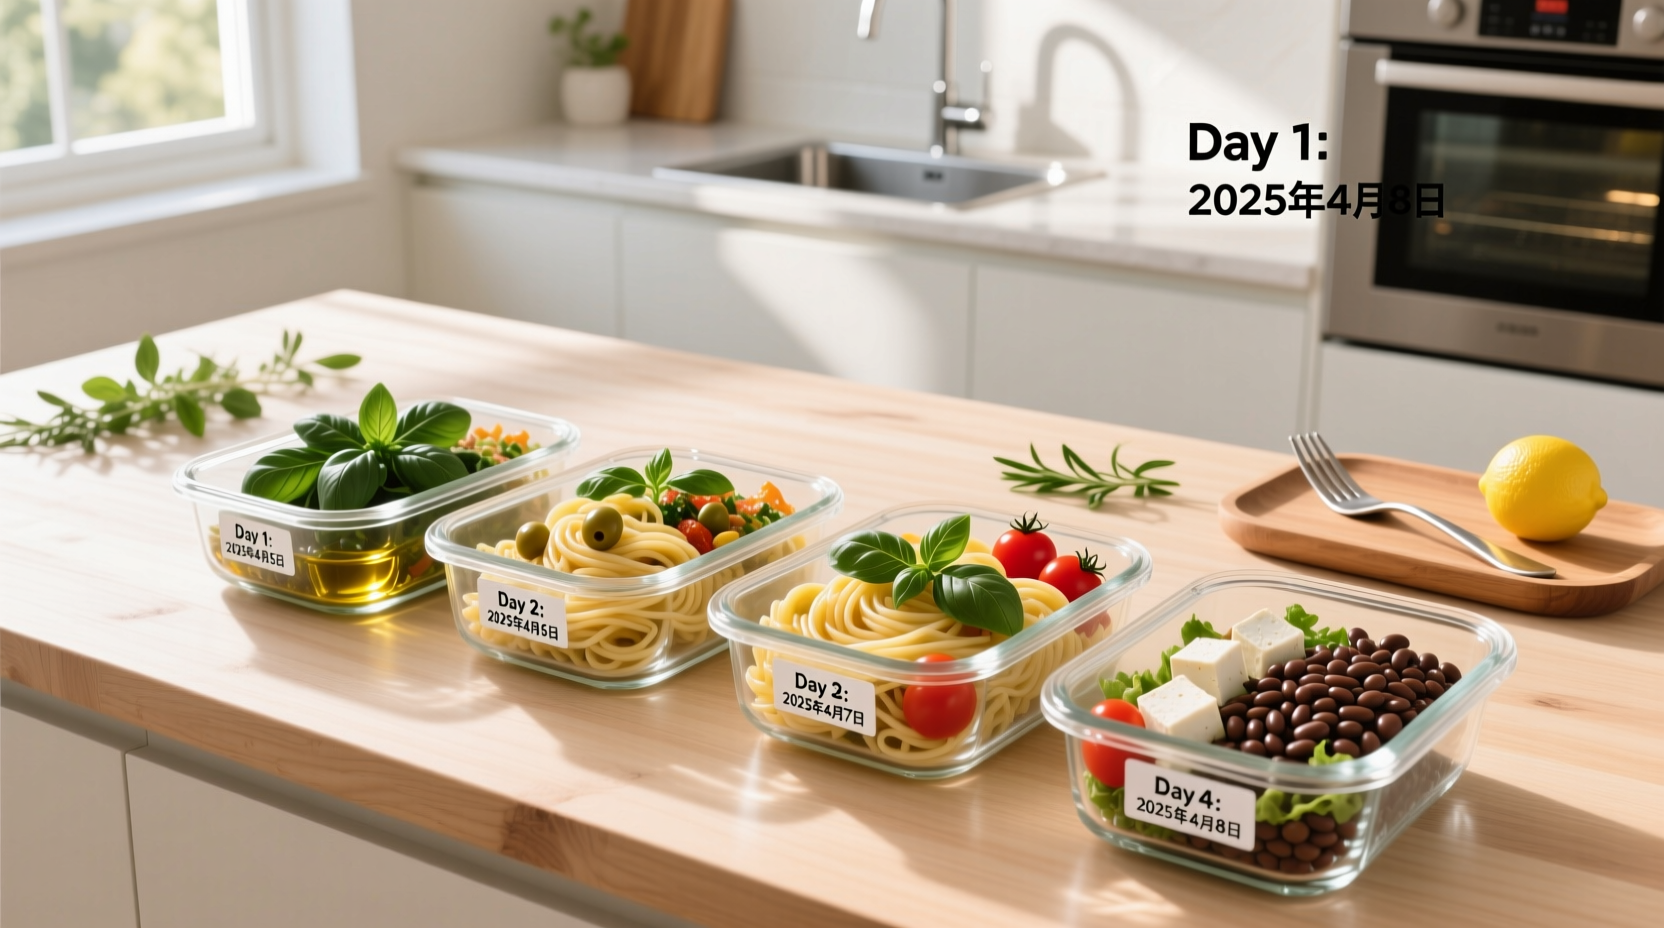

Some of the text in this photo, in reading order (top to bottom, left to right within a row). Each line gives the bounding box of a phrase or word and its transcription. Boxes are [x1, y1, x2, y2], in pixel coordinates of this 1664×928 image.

[235, 523, 273, 548] Day 1:
[498, 590, 544, 618] Day 2:
[795, 671, 849, 703] Day 2:
[782, 691, 864, 727] 2025年4月7日
[1154, 775, 1221, 812] Day 4:
[1136, 797, 1241, 840] 2025年4月8日
